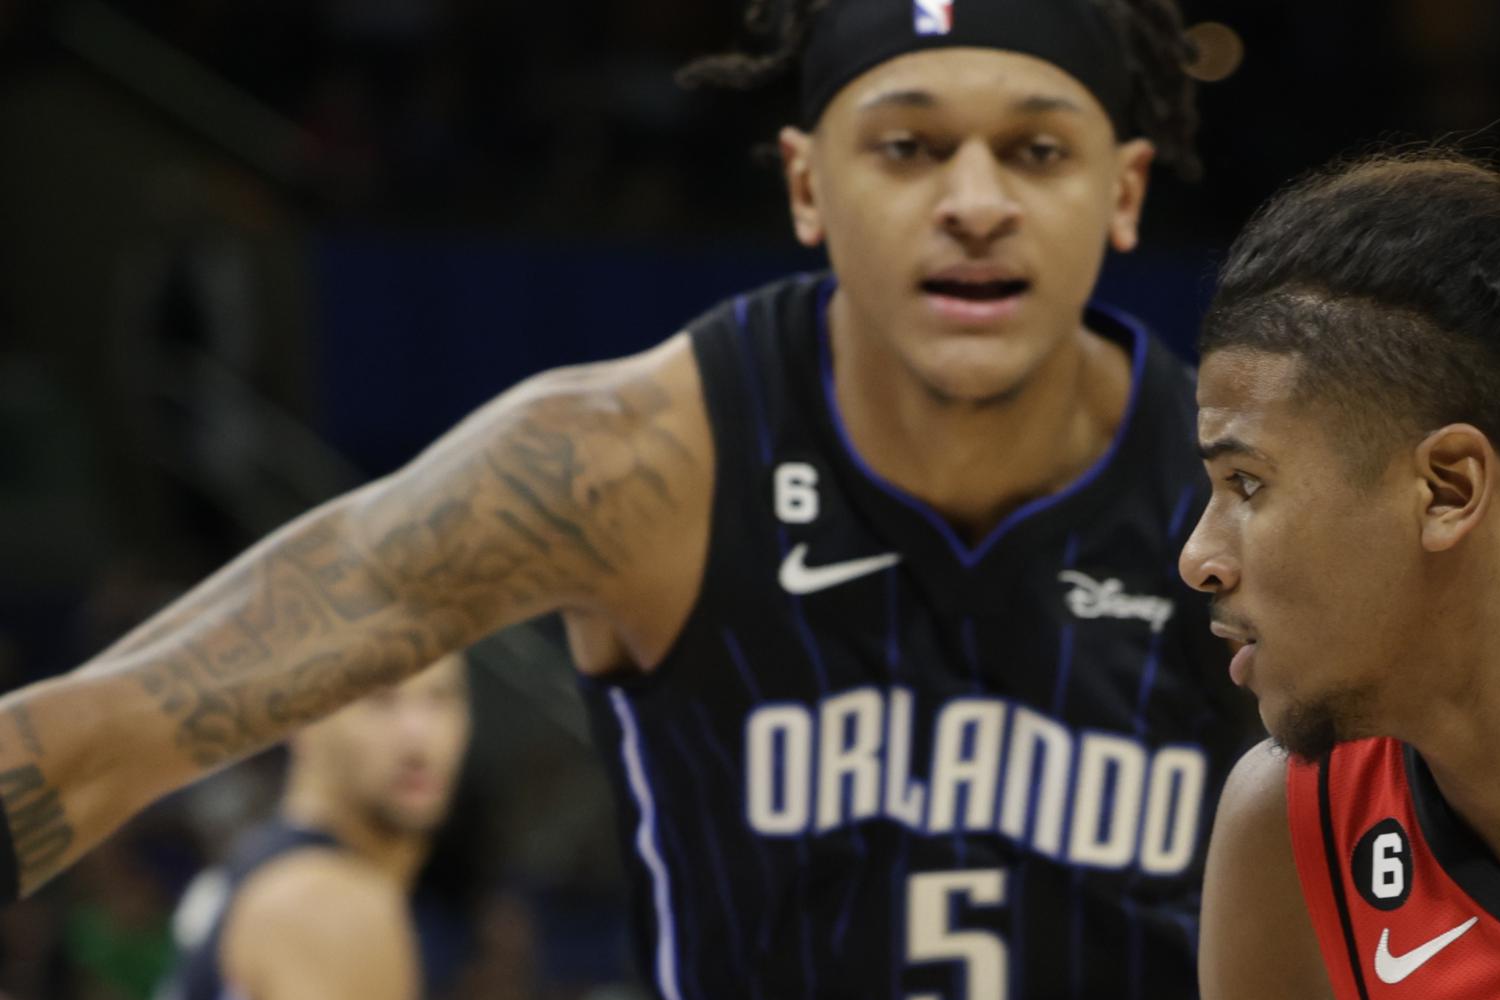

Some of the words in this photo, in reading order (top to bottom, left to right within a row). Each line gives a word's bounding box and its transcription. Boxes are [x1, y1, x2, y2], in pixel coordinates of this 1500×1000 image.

[774, 462, 819, 524] 6
[1058, 569, 1174, 633] Disney
[745, 686, 1206, 875] ORLANDO
[1371, 832, 1404, 899] 6
